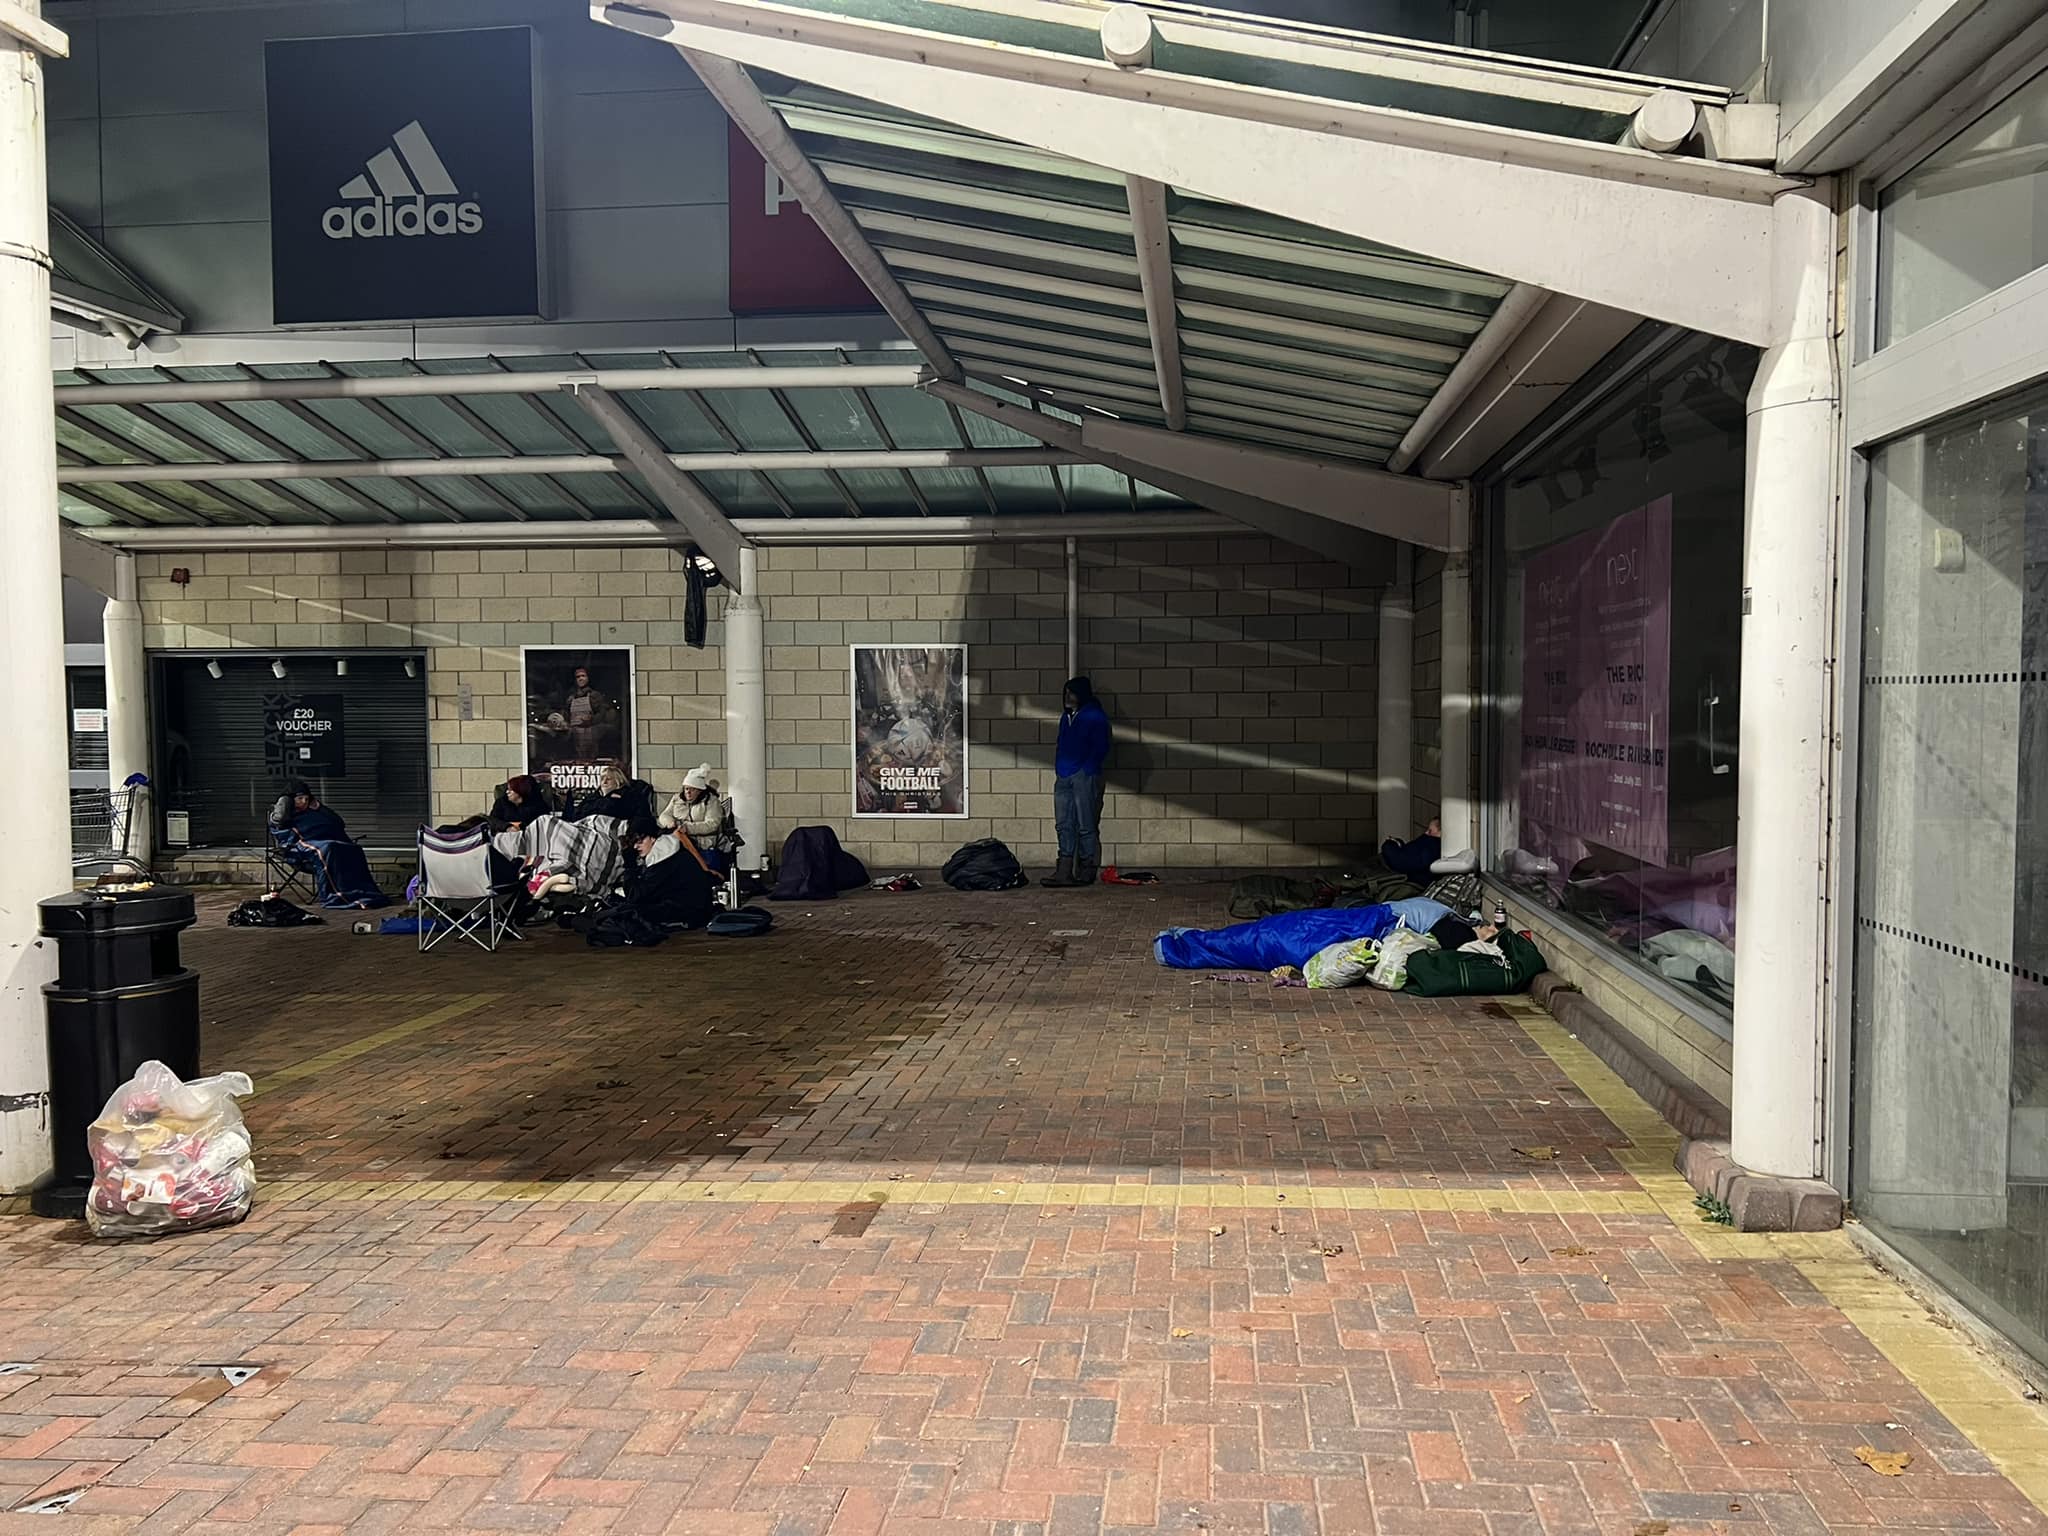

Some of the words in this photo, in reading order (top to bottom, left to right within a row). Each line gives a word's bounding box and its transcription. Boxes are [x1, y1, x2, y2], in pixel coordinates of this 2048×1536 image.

[322, 196, 484, 239] adidas
[294, 708, 314, 719] £20
[276, 720, 332, 730] VOUCHER
[550, 765, 585, 775] GIVE
[880, 767, 915, 776] GIVE
[917, 767, 941, 776] ME
[880, 776, 941, 790] FOOTBALL
